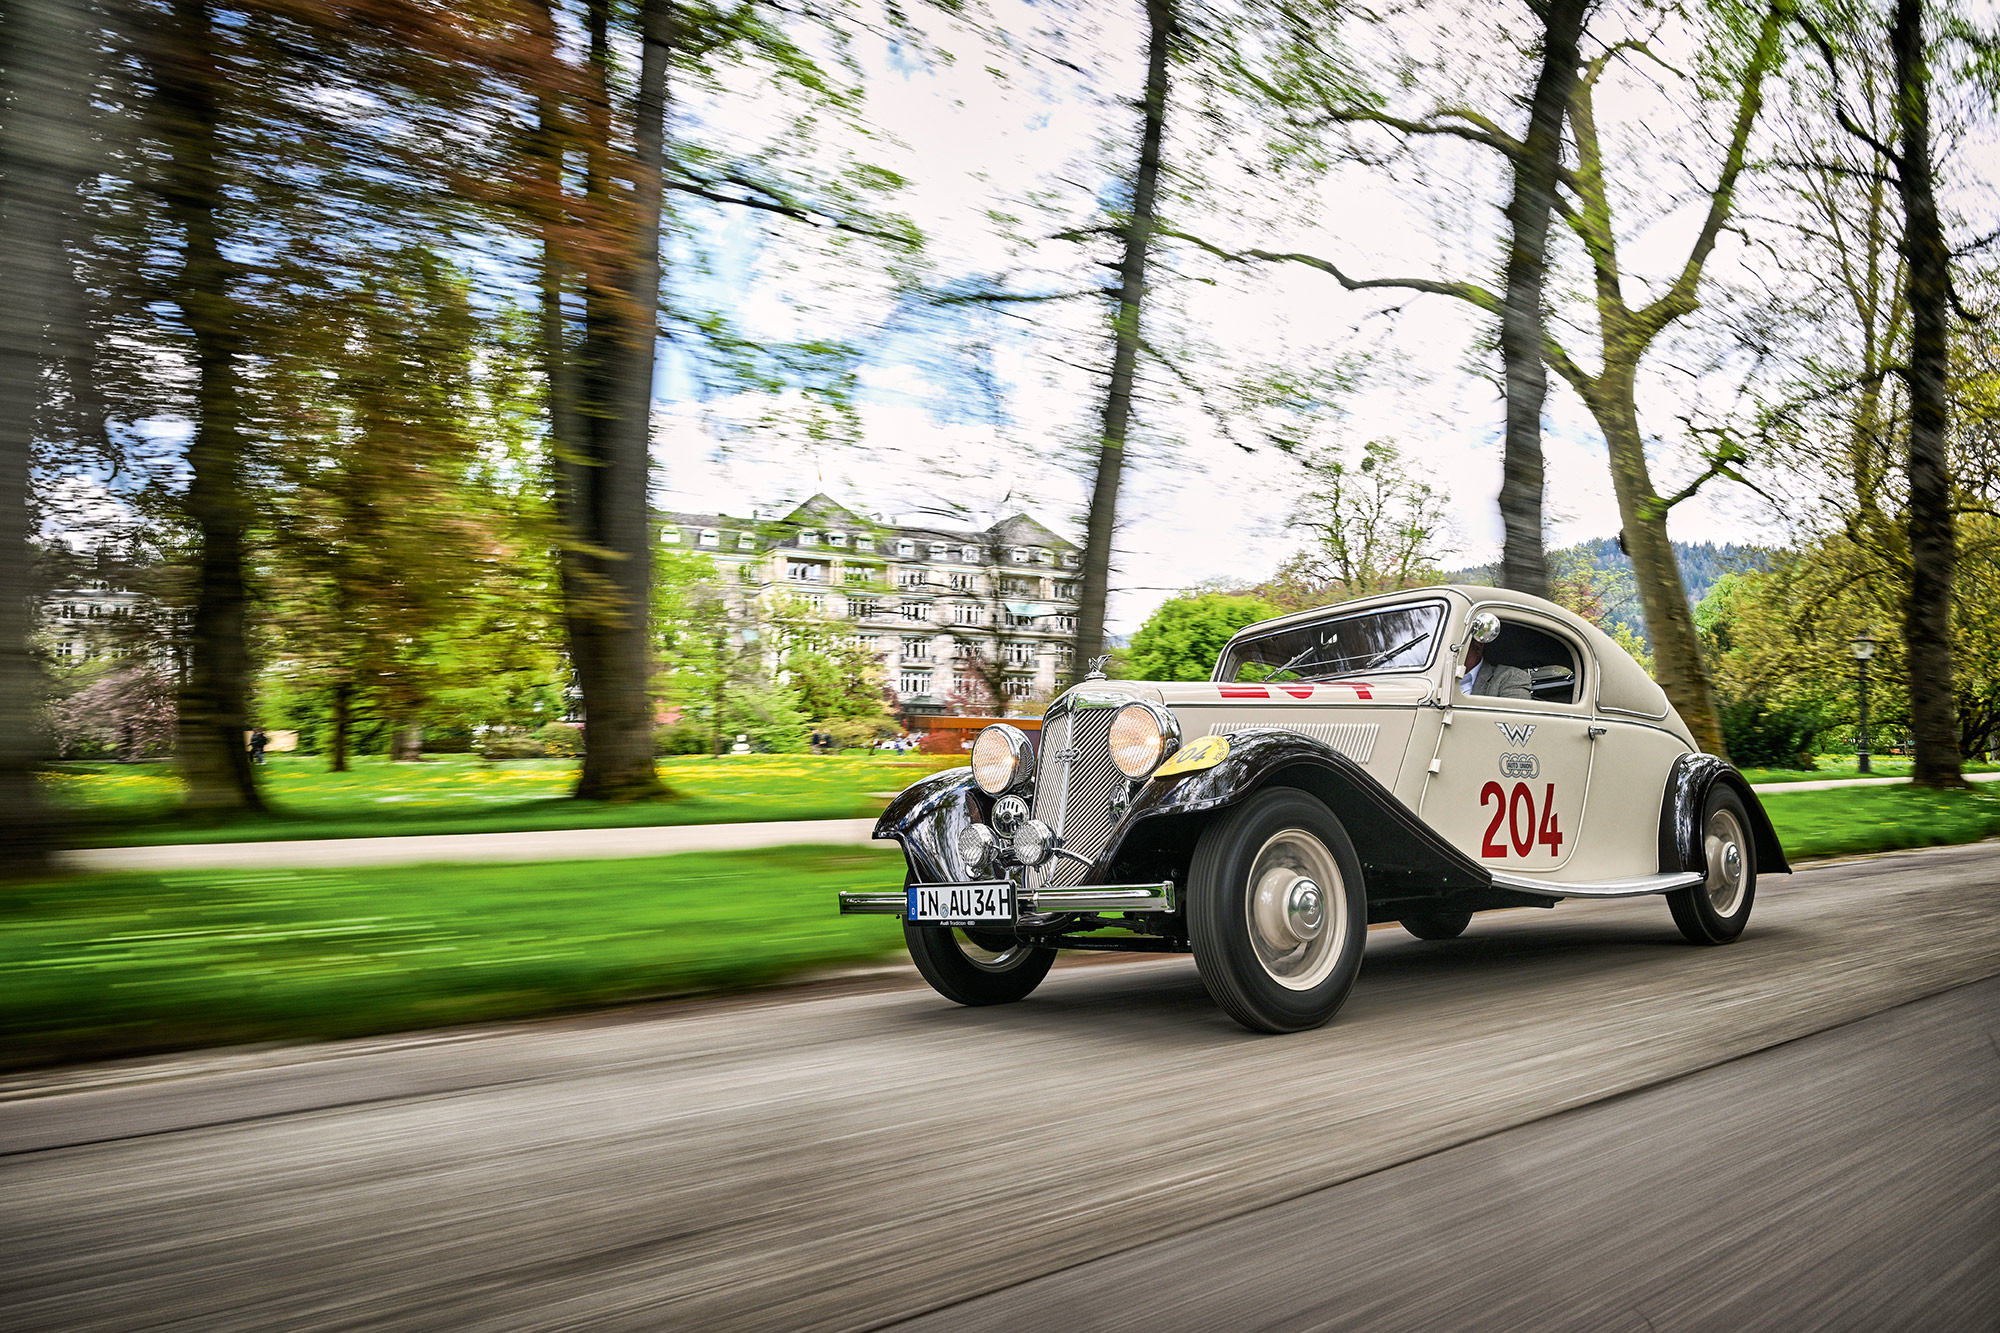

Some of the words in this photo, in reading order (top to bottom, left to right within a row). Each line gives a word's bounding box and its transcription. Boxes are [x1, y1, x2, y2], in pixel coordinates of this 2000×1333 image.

[1480, 780, 1563, 858] 204
[911, 907, 916, 915] D
[919, 891, 939, 916] IN
